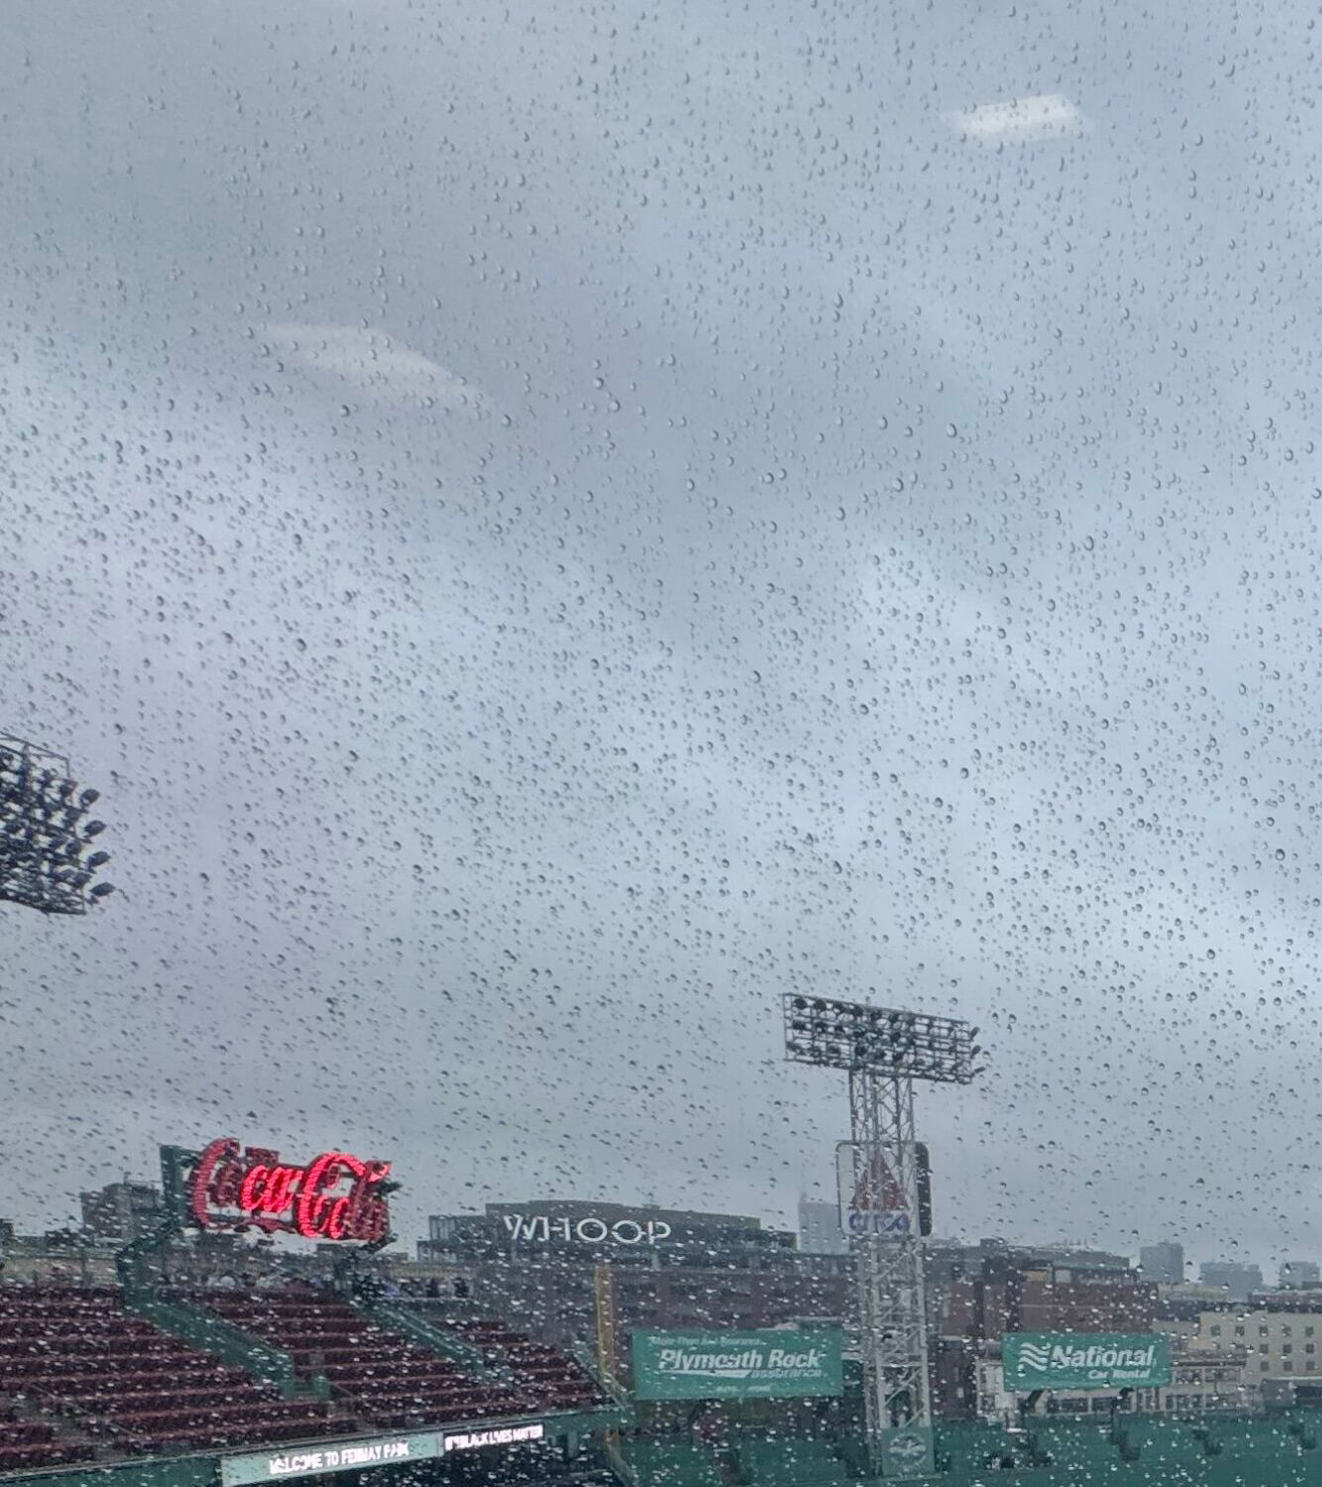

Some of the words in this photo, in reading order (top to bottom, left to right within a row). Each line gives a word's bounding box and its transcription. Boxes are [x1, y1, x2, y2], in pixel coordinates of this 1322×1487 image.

[502, 1213, 672, 1244] WHOOP
[657, 1349, 763, 1371] Plymouth
[767, 1349, 822, 1368] Rock
[1052, 1345, 1156, 1369] National
[749, 1368, 823, 1379] assurance
[1088, 1369, 1108, 1379] Car
[1112, 1368, 1151, 1379] Rental
[269, 1452, 323, 1475] WELCOME
[325, 1451, 339, 1467] TO
[340, 1444, 382, 1466] FENWAY
[384, 1442, 410, 1461] PARK
